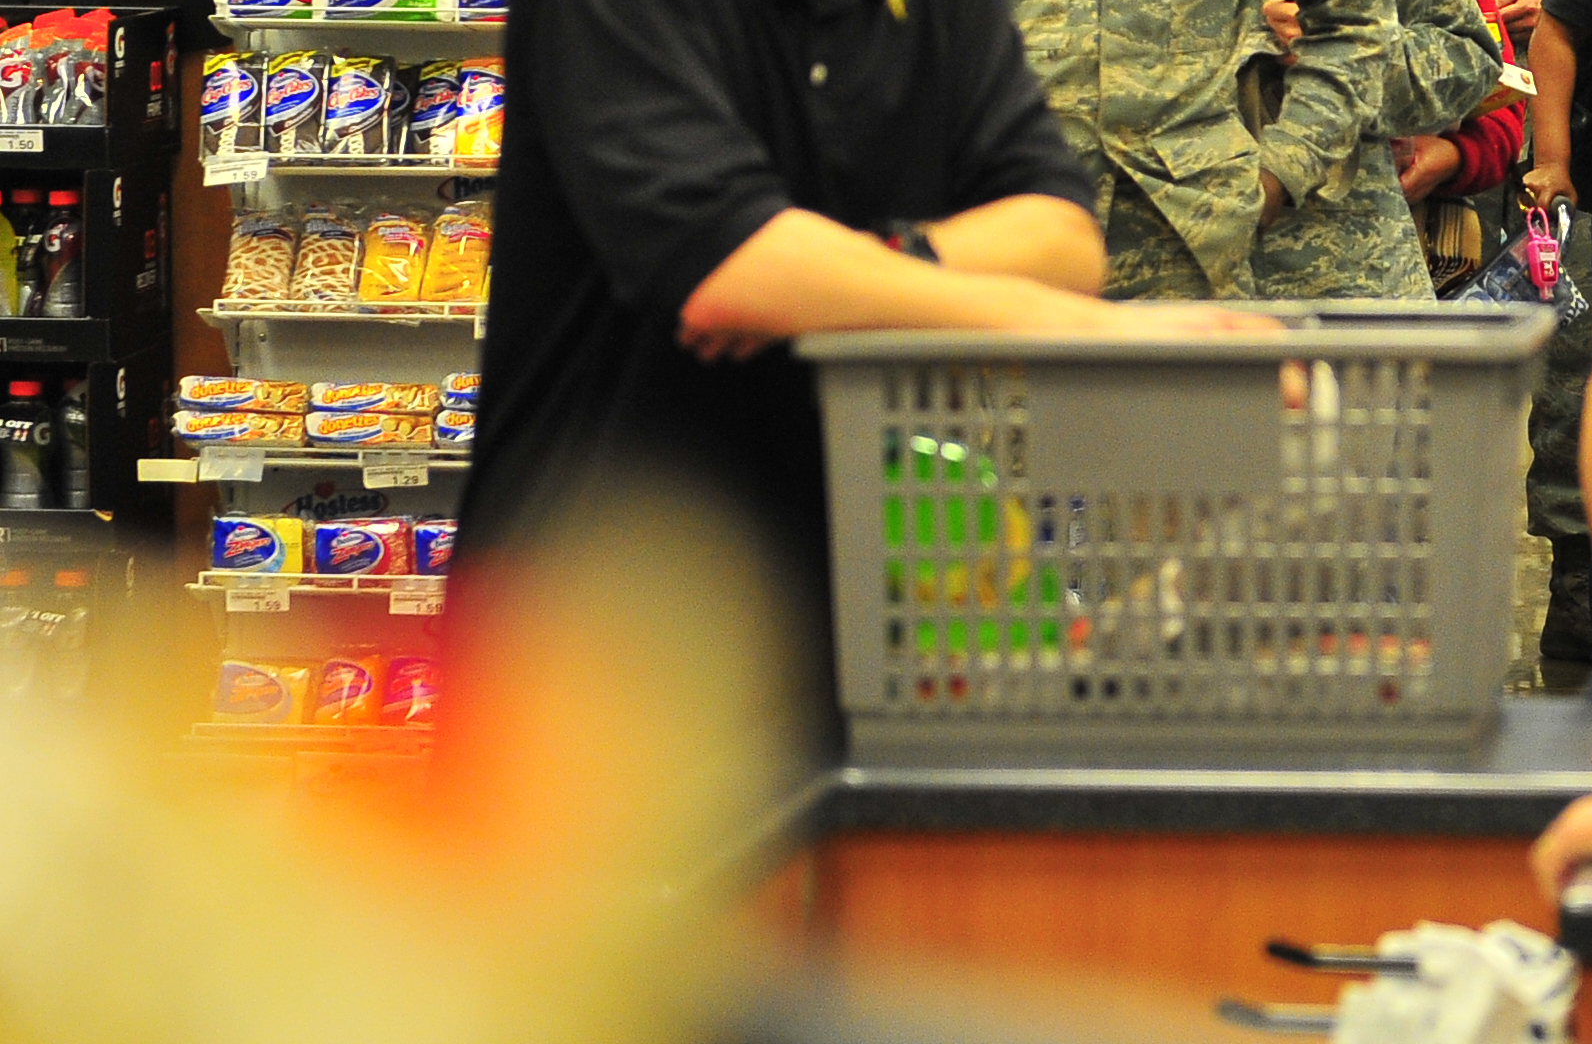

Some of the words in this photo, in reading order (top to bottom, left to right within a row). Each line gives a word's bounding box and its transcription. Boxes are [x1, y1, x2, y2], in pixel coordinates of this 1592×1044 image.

[115, 26, 125, 59] G
[8, 140, 34, 150] 1.50
[113, 176, 122, 209] G
[318, 413, 379, 435] donettes
